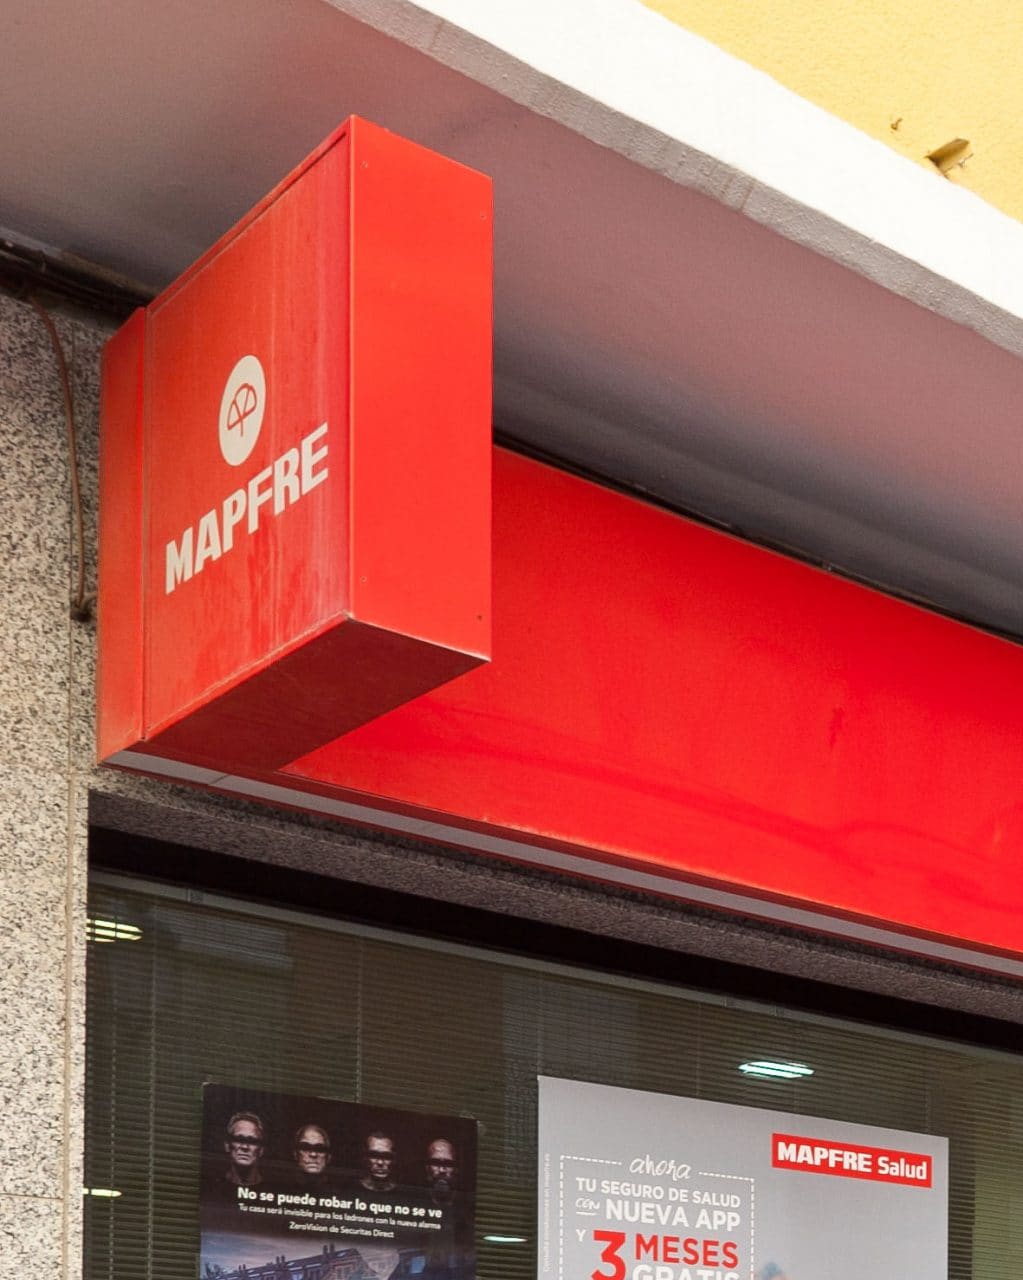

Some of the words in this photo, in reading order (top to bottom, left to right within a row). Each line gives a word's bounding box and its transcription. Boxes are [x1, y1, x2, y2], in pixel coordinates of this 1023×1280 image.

[166, 421, 328, 595] MAPFRE
[629, 1154, 691, 1181] ahora
[778, 1141, 872, 1173] MAPFRE
[878, 1156, 927, 1180] Salud
[238, 1186, 256, 1200] No
[260, 1191, 273, 1202] se
[277, 1193, 315, 1206] puede
[319, 1196, 352, 1210] robar
[355, 1199, 367, 1211] lo
[371, 1201, 391, 1214] que
[395, 1204, 409, 1215] no
[413, 1206, 425, 1217] se
[428, 1207, 442, 1218] ve
[576, 1177, 597, 1193] TU
[601, 1180, 664, 1200] SEGURO
[668, 1188, 689, 1203] DE
[692, 1190, 741, 1208] SALUD
[284, 1206, 313, 1218] invisible
[314, 1210, 332, 1221] para
[332, 1211, 344, 1220] los
[344, 1212, 374, 1223] ladrones
[606, 1198, 689, 1228] NUEVA
[695, 1208, 741, 1232] APP
[329, 1224, 339, 1233] de
[341, 1226, 373, 1237] Securitas
[373, 1228, 395, 1238] Direct
[575, 1228, 586, 1242] Y
[635, 1232, 738, 1268] MESES
